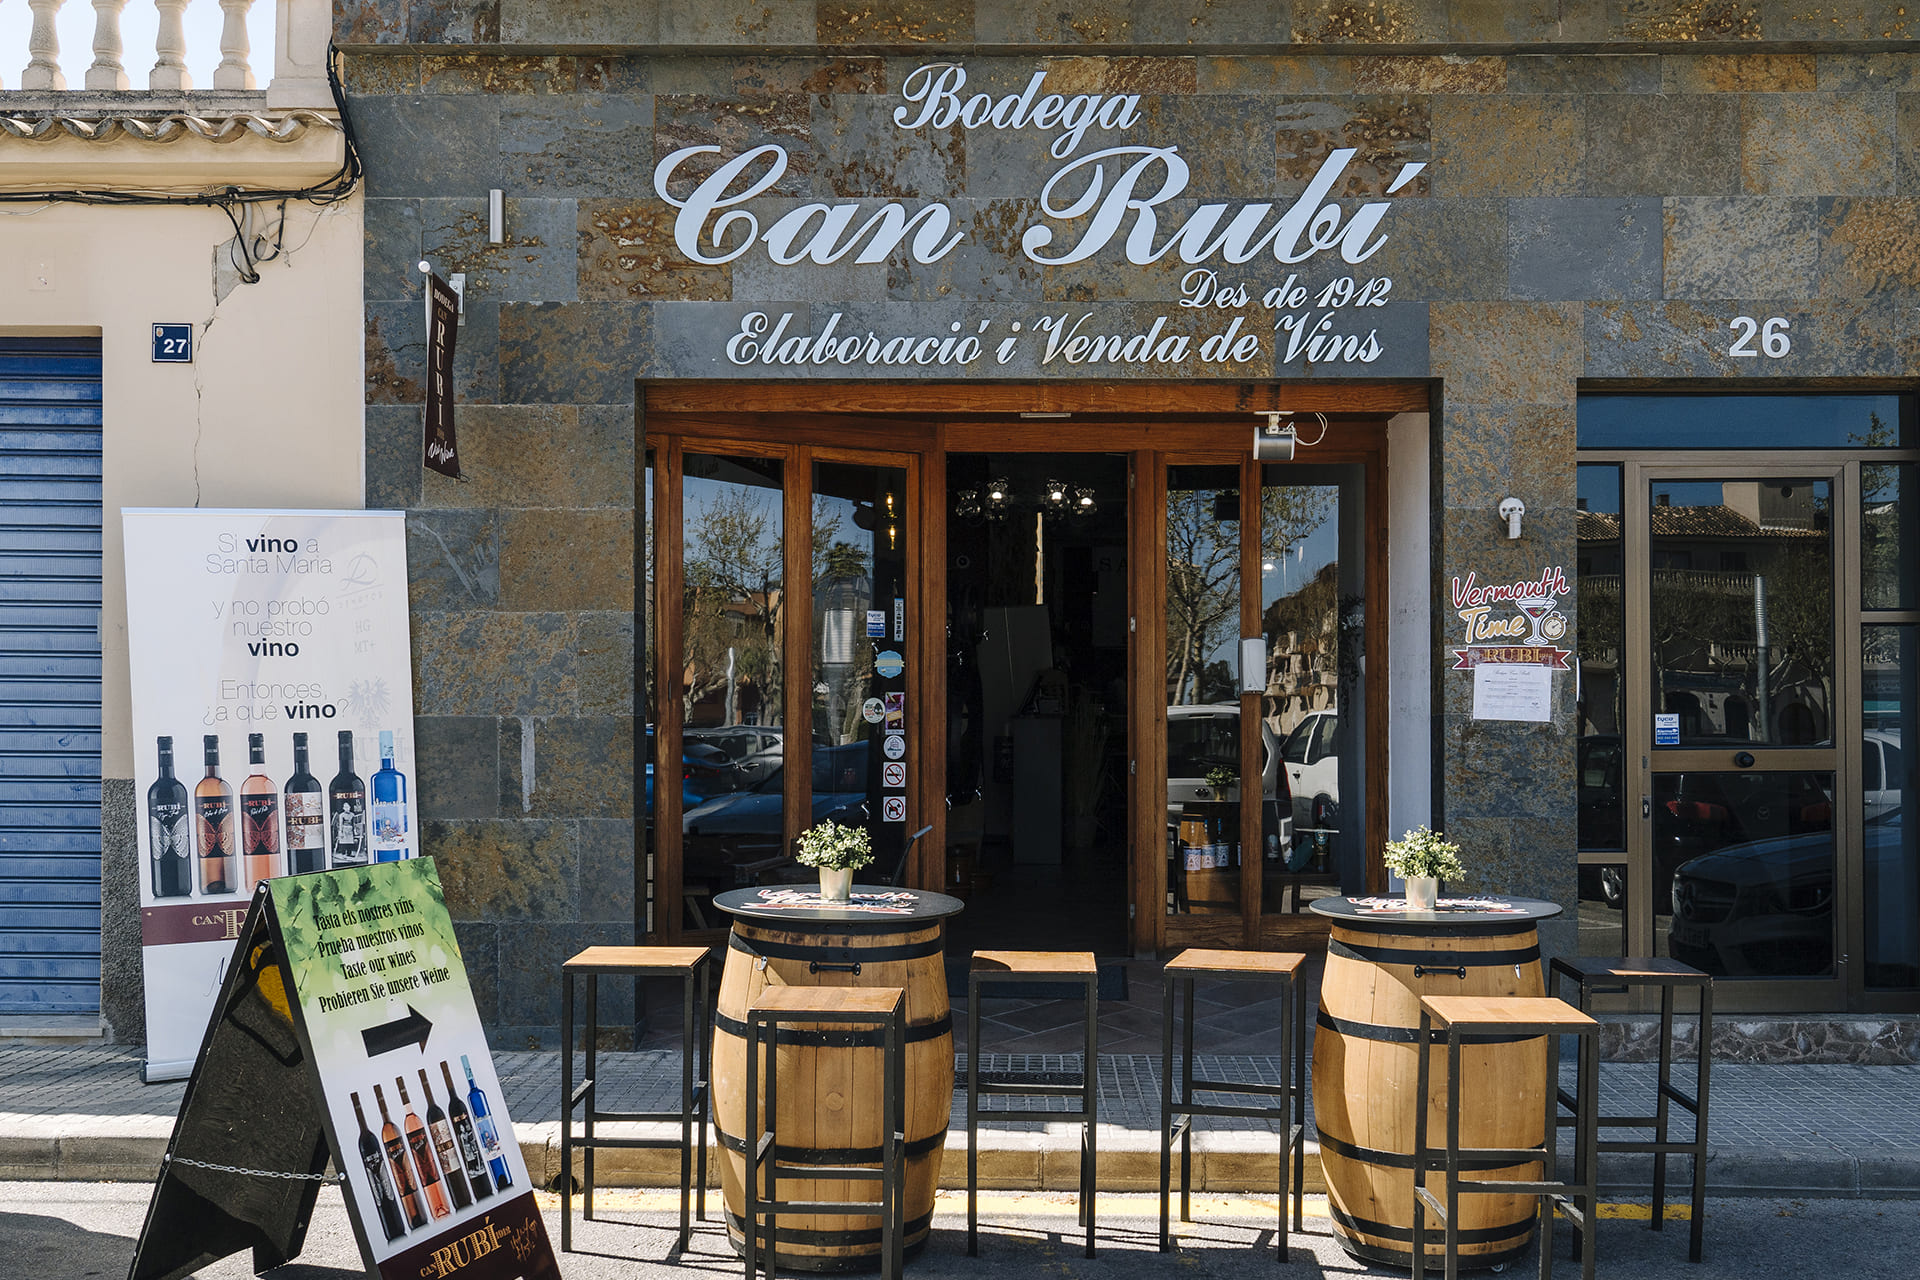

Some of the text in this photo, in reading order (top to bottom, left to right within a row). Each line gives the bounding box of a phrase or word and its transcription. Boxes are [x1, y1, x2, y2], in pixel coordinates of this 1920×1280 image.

[893, 61, 1141, 160] Bodega
[653, 144, 1428, 267] Can Rubí
[1179, 269, 1392, 309] Des de 1912
[163, 338, 187, 354] 27
[726, 311, 1384, 367] Elaboració i Venda de Vins
[1729, 316, 1791, 359] 26
[217, 533, 319, 553] Si vino a
[205, 554, 333, 574] Santa Maria
[1453, 567, 1570, 608] Vermouth
[211, 599, 225, 619] y
[232, 598, 260, 616] no
[267, 595, 330, 620] probó
[233, 618, 313, 637] nuestro
[1459, 606, 1526, 643] Time
[247, 638, 300, 657] vino
[1484, 645, 1541, 663] RUBÍ
[221, 679, 328, 701] Entonces,
[202, 704, 229, 726] ¿a
[236, 702, 278, 727] qué
[192, 914, 225, 926] CAN
[313, 911, 342, 931] Tasta
[342, 908, 357, 926] els
[358, 903, 394, 922] nostres
[317, 921, 425, 958] Prueba nuestros vinos
[340, 949, 417, 980] Taste our wines
[318, 966, 451, 1013] Probieren Sie unsere Weine
[430, 1216, 502, 1279] RUBÍ
